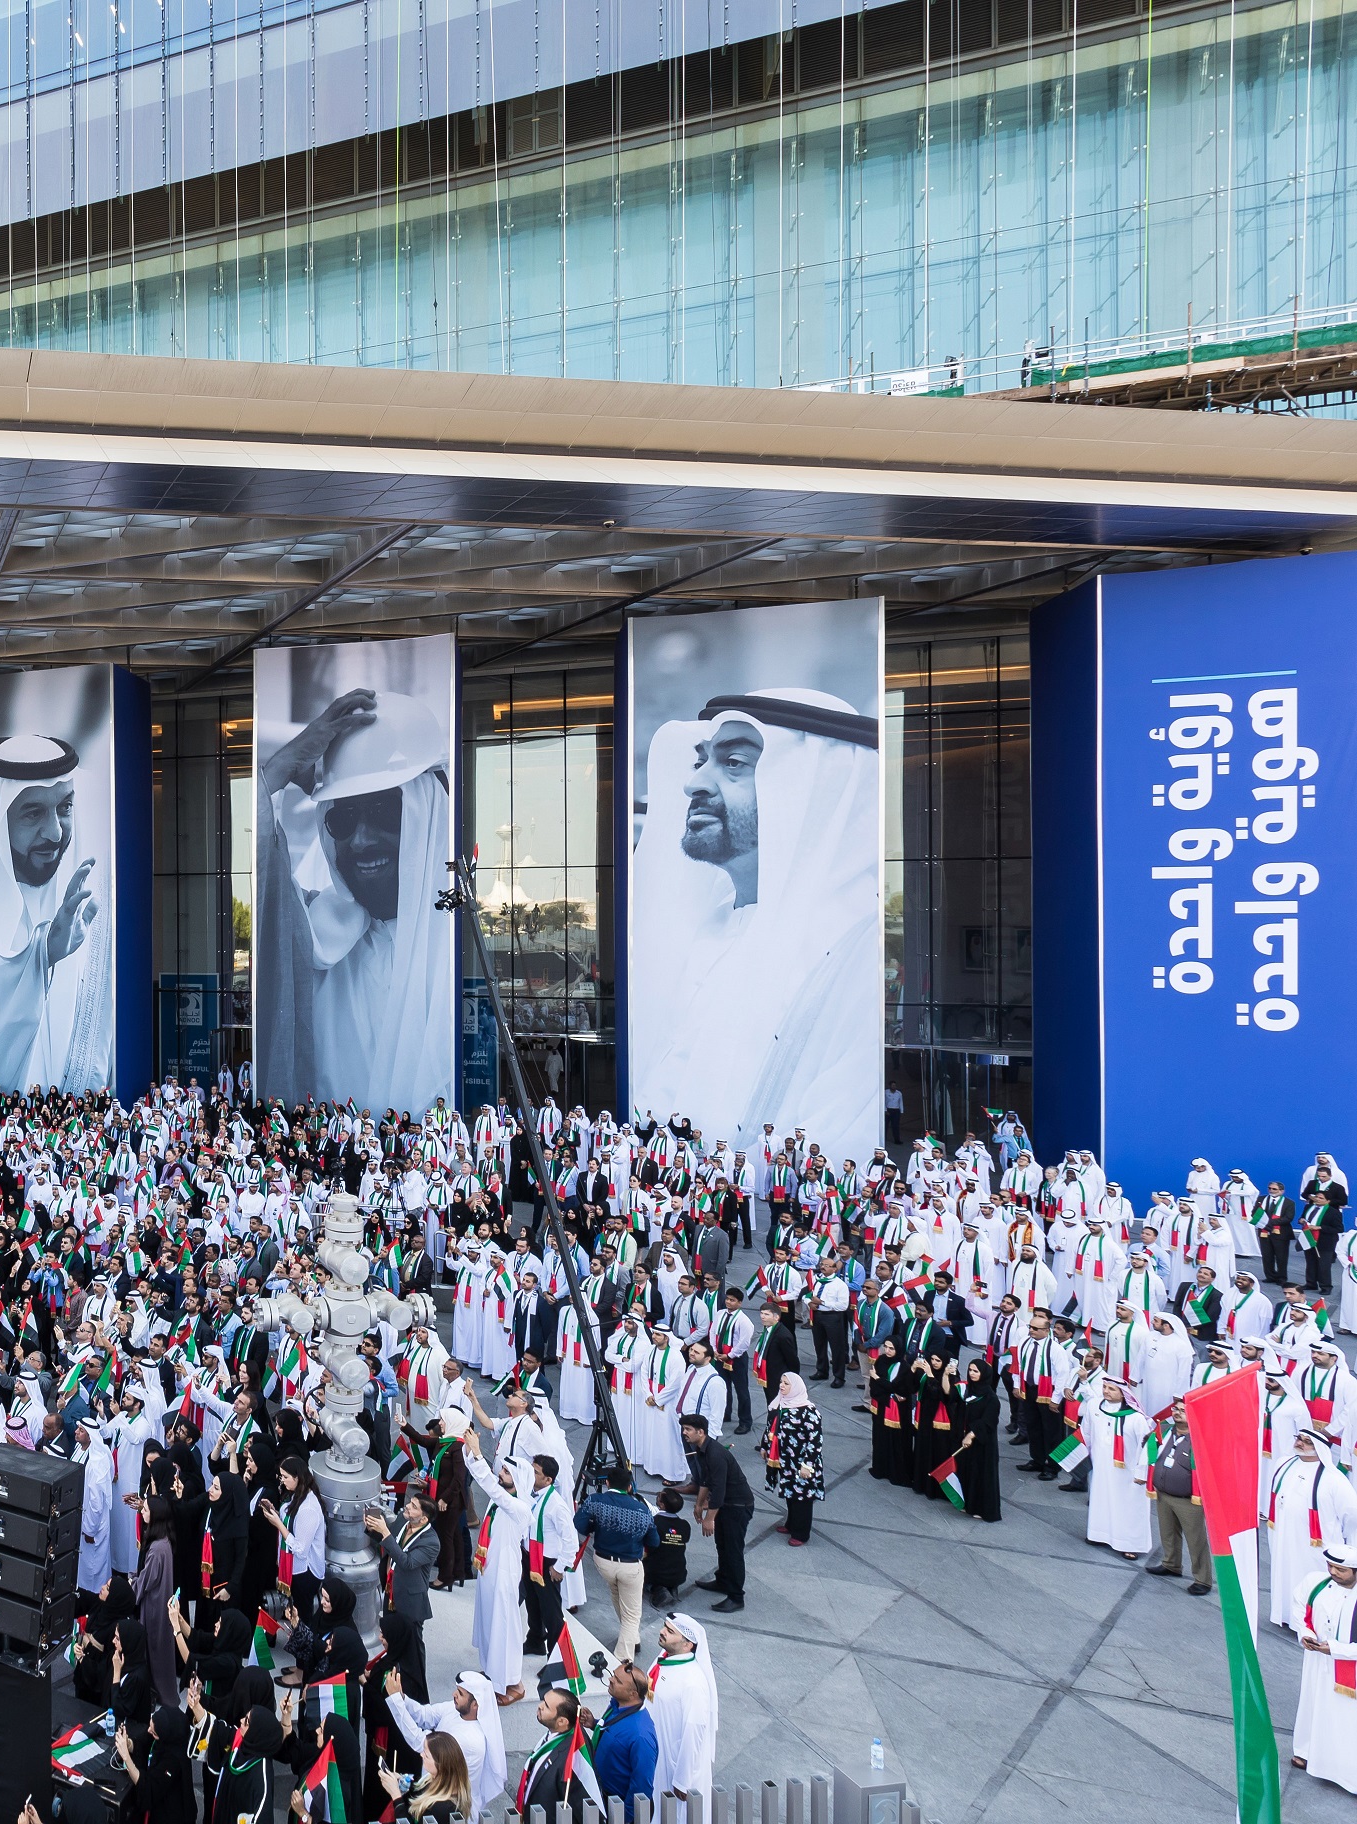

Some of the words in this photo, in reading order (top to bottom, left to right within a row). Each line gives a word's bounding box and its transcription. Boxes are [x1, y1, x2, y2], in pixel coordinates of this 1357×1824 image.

[1149, 692, 1234, 811] رؤية
[1235, 688, 1320, 844] هوية
[1152, 828, 1234, 994] واحدة
[1234, 862, 1320, 1032] واحدة
